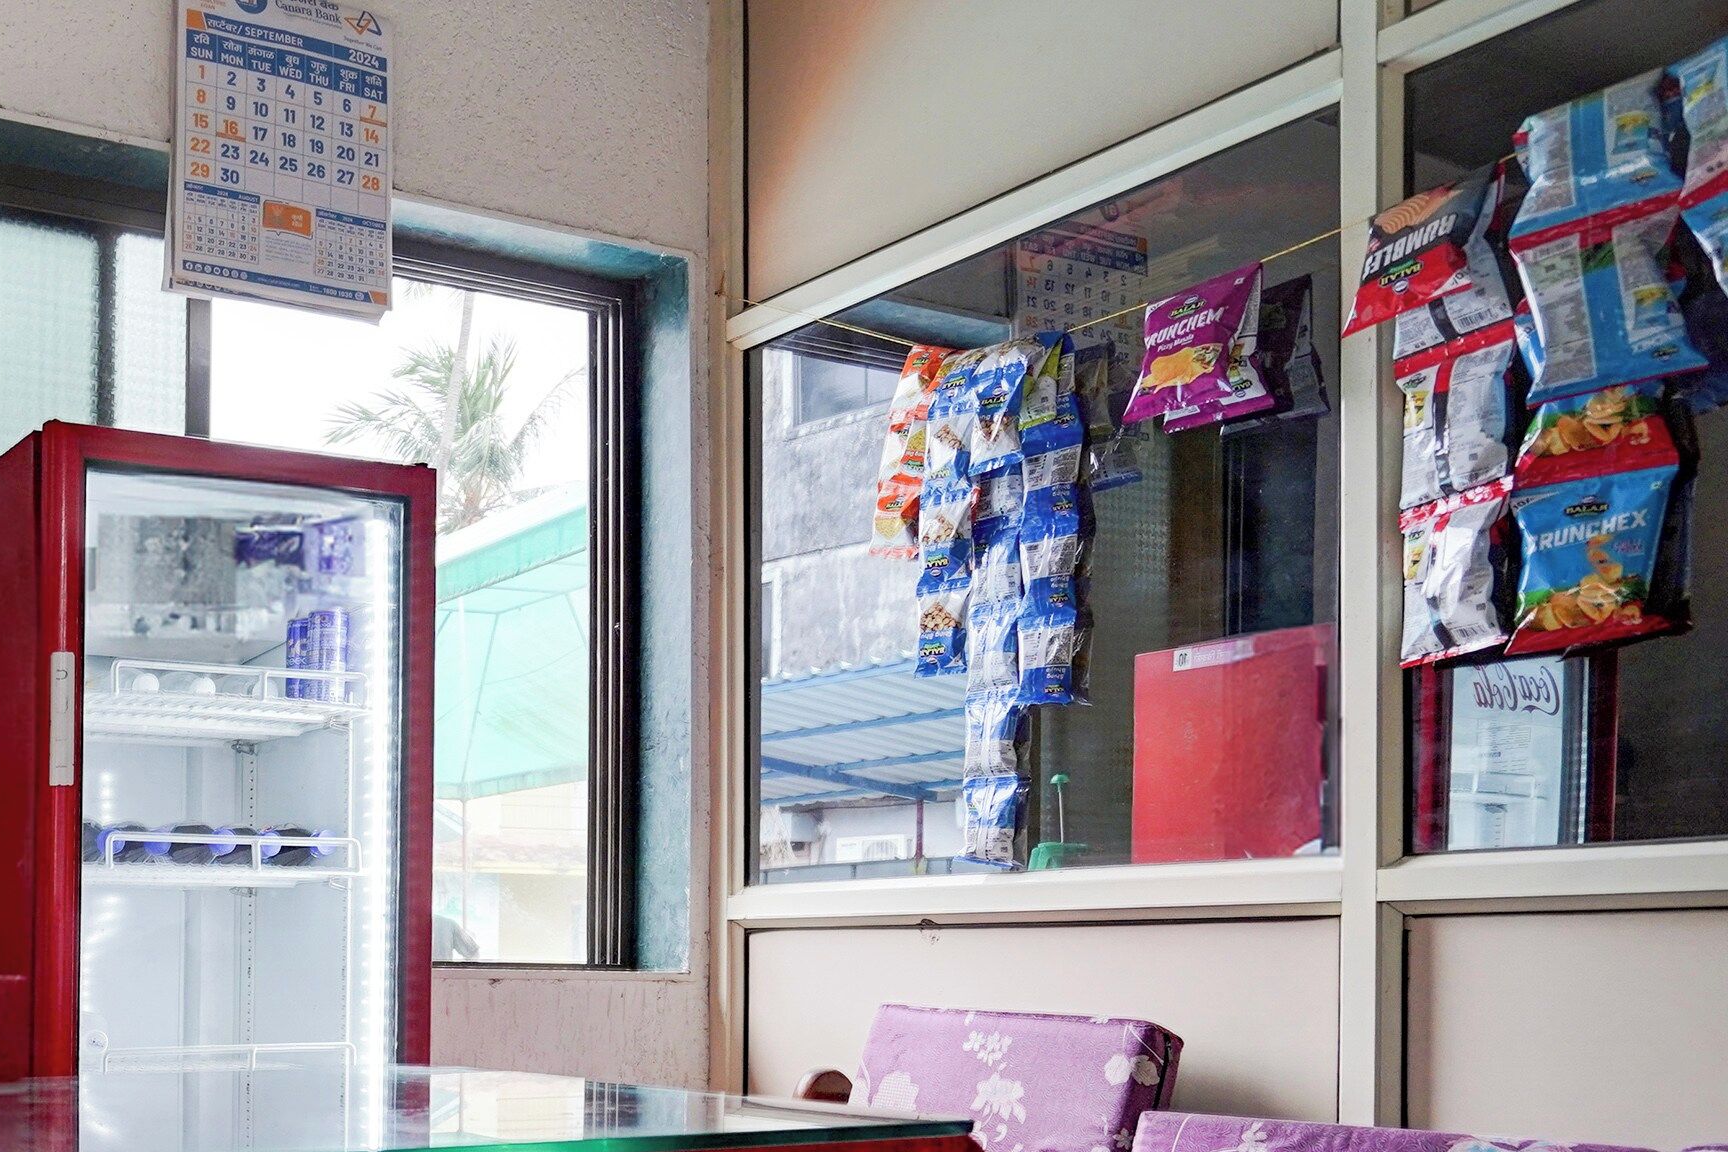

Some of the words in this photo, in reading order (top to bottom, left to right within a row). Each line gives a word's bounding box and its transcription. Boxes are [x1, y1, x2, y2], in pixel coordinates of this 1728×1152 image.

[275, 0, 313, 17] Canara
[315, 8, 342, 25] Bank
[190, 46, 213, 61] SUN
[221, 52, 244, 67] MON
[251, 59, 272, 74] TUE
[278, 65, 303, 81] WED
[309, 72, 329, 87] THU
[339, 79, 355, 94] FRI
[363, 87, 384, 102] SAT
[244, 26, 304, 48] SEPTEMBER
[348, 49, 380, 69] 2024
[196, 88, 206, 104] 8
[226, 96, 236, 111] 9
[252, 101, 269, 118] 10
[283, 108, 296, 125] 11
[310, 114, 325, 131] 12
[339, 121, 354, 138] 13
[363, 127, 379, 145] 14
[198, 64, 206, 80] 1
[226, 71, 237, 87] 2
[256, 77, 266, 93] 3
[284, 84, 296, 100] 4
[313, 91, 323, 106] 5
[342, 98, 352, 113] 6
[368, 105, 377, 119] 7
[190, 136, 210, 155] 22
[221, 143, 240, 161] 23
[249, 149, 270, 167] 24
[278, 155, 298, 173] 25
[307, 161, 326, 180] 26
[336, 168, 355, 186] 27
[361, 173, 381, 192] 28
[192, 112, 209, 129] 15
[223, 119, 239, 136] 16
[252, 126, 268, 142] 17
[281, 132, 297, 149] 18
[309, 138, 324, 155] 19
[336, 145, 355, 162] 20
[364, 151, 379, 168] 21
[190, 160, 210, 179] 29
[220, 167, 240, 185] 30
[1362, 213, 1458, 280] RUMBLES
[1380, 263, 1422, 287] BALAJI
[1170, 299, 1206, 317] BALAJI
